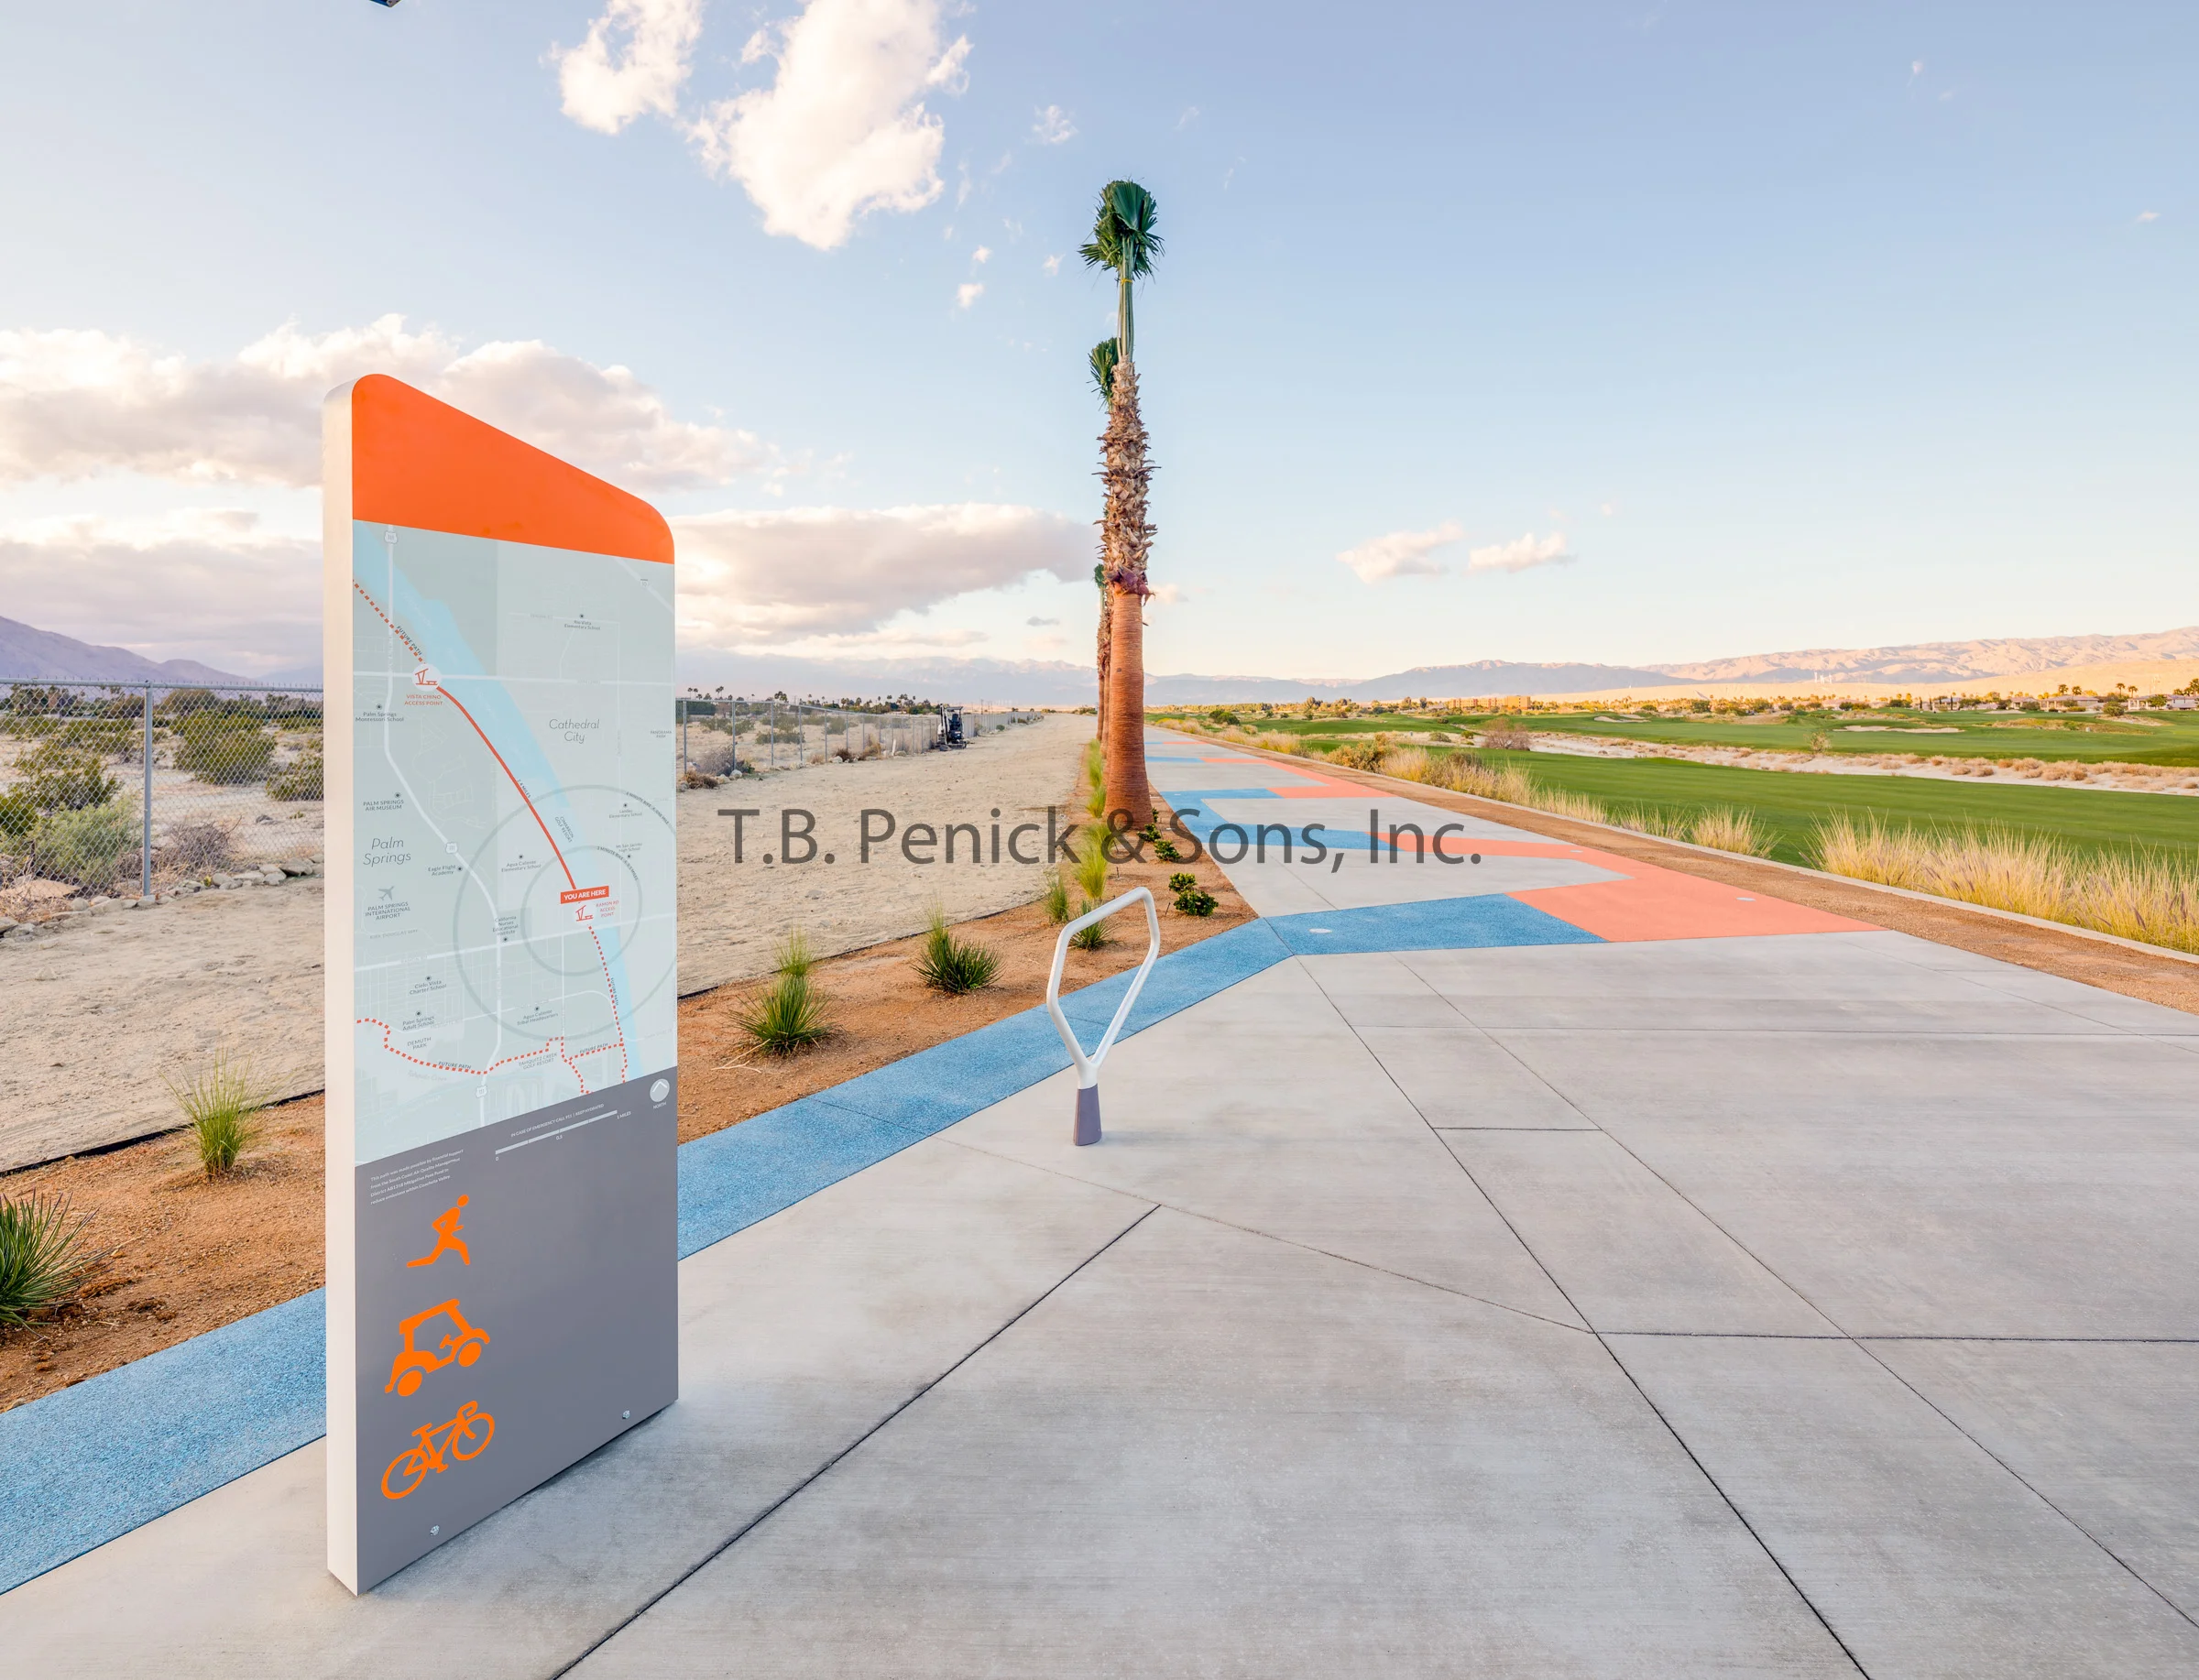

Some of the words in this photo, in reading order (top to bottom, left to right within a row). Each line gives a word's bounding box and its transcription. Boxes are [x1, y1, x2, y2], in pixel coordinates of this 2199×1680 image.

[396, 626, 412, 643] FUTURE
[411, 642, 422, 656] PATH
[549, 718, 600, 730] Cathedral
[563, 730, 585, 744] City
[560, 816, 574, 838] CIMARRON
[562, 826, 573, 843] RESORT
[371, 835, 404, 850] Palm
[363, 852, 411, 867] Springs
[563, 892, 577, 900] YOU
[591, 889, 607, 897] HERE
[365, 906, 410, 917] INTERNATIONAL
[376, 912, 400, 921] AIRPORT
[409, 987, 430, 995] Charter
[416, 1015, 435, 1023] Springs
[530, 1012, 559, 1023] Headquarters
[418, 1020, 435, 1028] School
[407, 1036, 432, 1047] DEMUTH
[579, 1045, 596, 1053] FUTURE
[536, 1058, 554, 1066] RESORT
[652, 1101, 667, 1109] NORTH
[620, 1110, 632, 1118] MILES
[516, 1129, 527, 1137] CASE
[532, 1119, 556, 1131] EMERGENCY
[585, 1103, 605, 1113] HYDRATED
[410, 1160, 427, 1169] possible
[432, 1152, 449, 1162] financial
[448, 1148, 464, 1157] support
[400, 1172, 413, 1180] Coast
[420, 1165, 435, 1173] Quality
[435, 1157, 460, 1169] Management
[370, 1188, 387, 1197] District
[403, 1176, 425, 1186] Mitigation
[370, 1197, 386, 1205] reduce
[385, 1190, 406, 1200] emissions
[405, 1185, 419, 1194] within
[418, 1179, 438, 1189] Coachella
